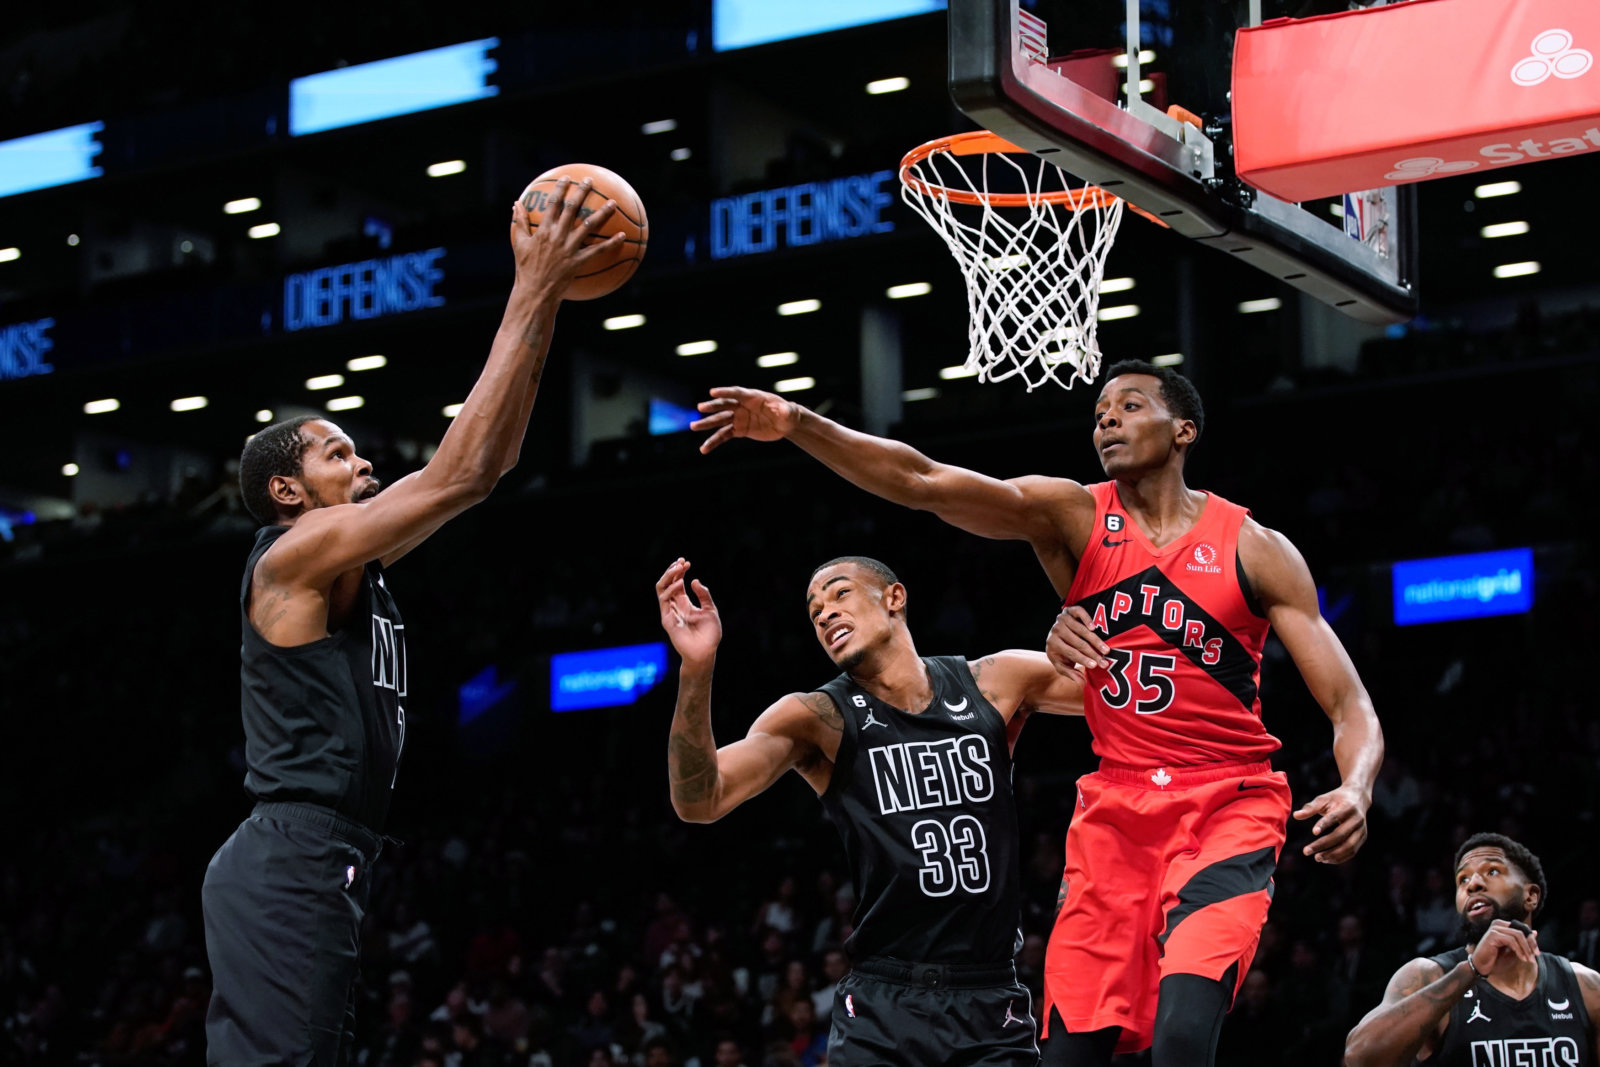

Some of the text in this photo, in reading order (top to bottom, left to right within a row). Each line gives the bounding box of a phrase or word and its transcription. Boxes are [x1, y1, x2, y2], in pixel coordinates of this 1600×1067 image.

[1107, 516, 1120, 531] 6
[1186, 562, 1222, 574] Sun Life
[1093, 584, 1223, 665] APTORS
[852, 695, 867, 708] 6
[1100, 648, 1176, 715] 35
[950, 711, 975, 721] Webull
[868, 734, 994, 815] NETS
[911, 815, 991, 897] 33
